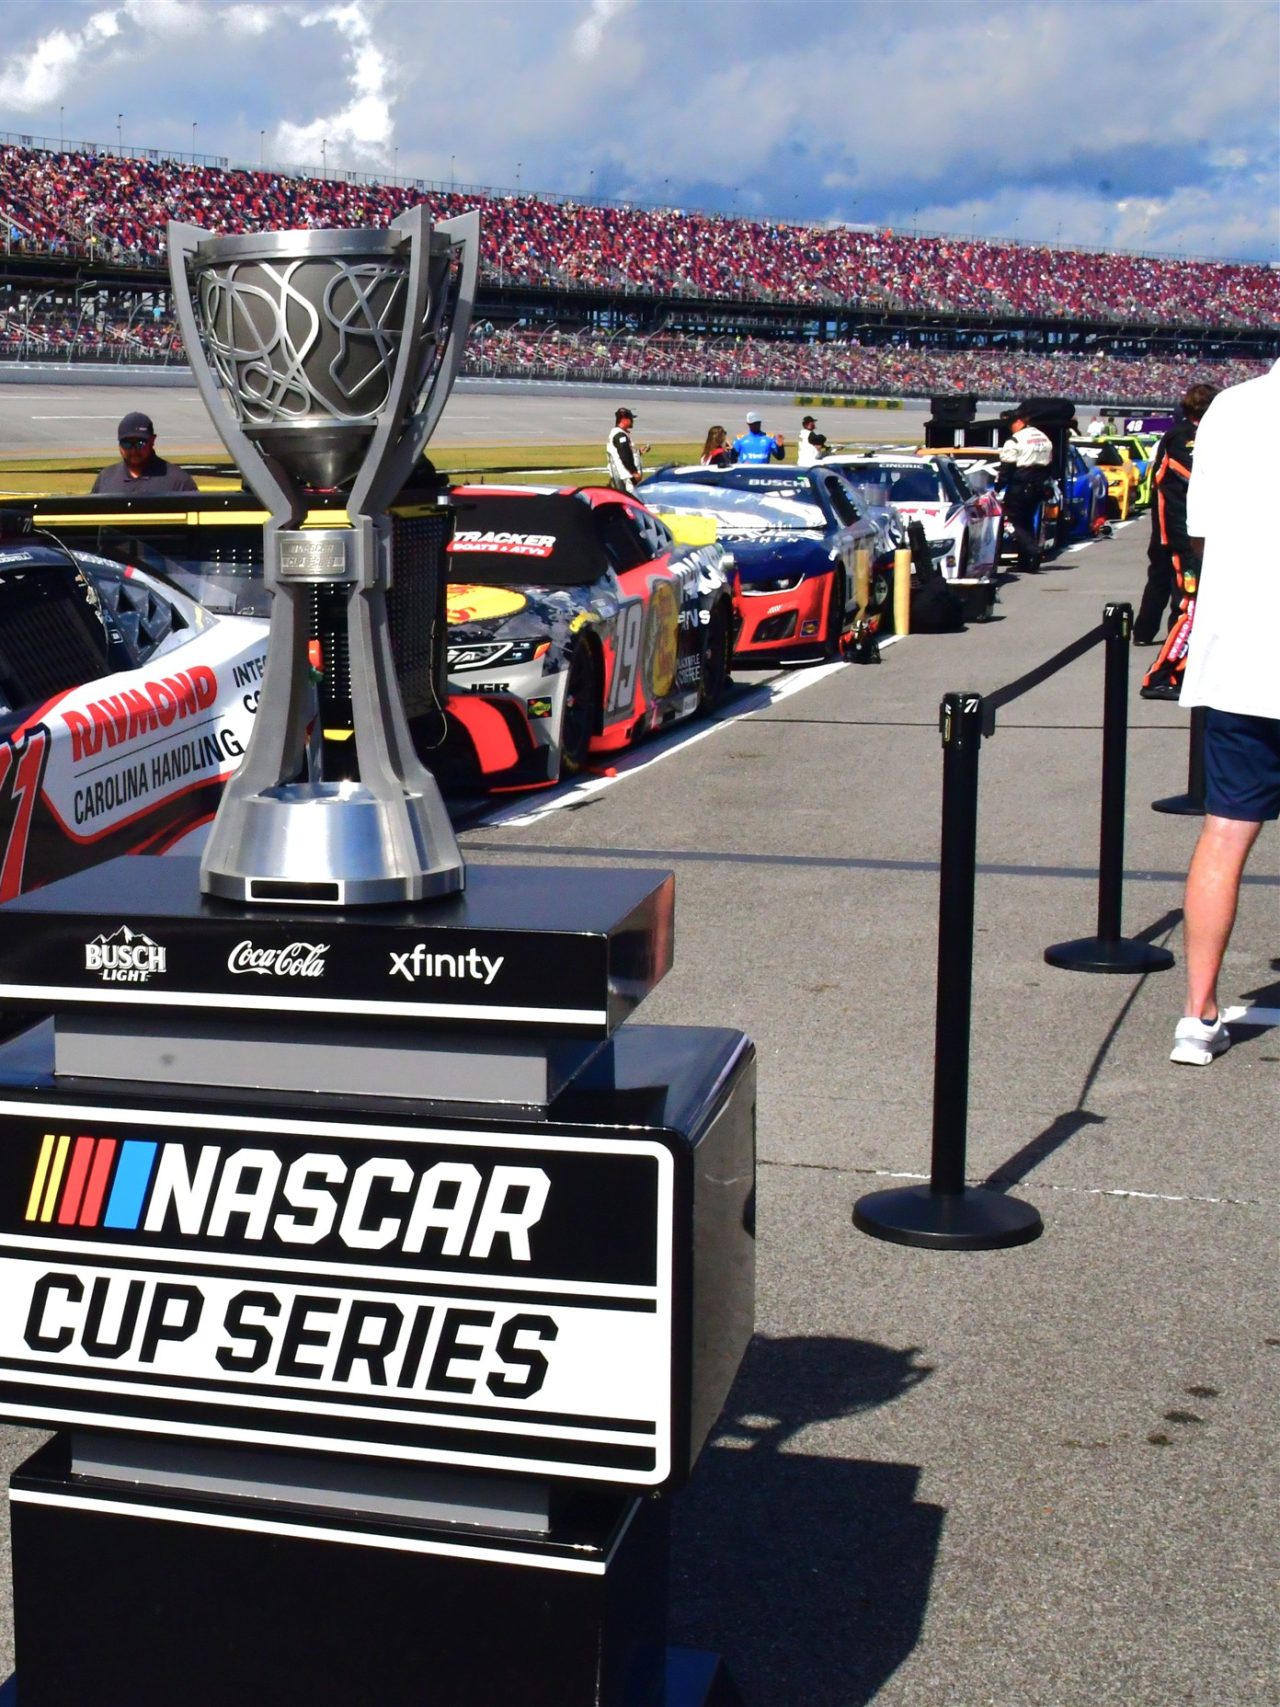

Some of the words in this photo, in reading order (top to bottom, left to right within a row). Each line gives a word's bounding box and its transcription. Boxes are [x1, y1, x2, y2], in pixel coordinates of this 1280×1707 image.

[748, 479, 806, 488] BUSCH
[454, 531, 557, 547] TRACKER
[608, 603, 642, 713] 19
[470, 683, 510, 694] JGR
[61, 665, 218, 762] RAYMOND
[74, 772, 149, 825] CAROLINA
[152, 729, 245, 790] HANDLING
[85, 942, 167, 972] BUSCH
[102, 968, 148, 982] LIGHT
[227, 939, 330, 978] Coca-Cola
[389, 944, 504, 984] xfinity
[144, 1142, 551, 1262] NASCAR
[23, 1271, 206, 1364] CUP
[215, 1290, 559, 1400] SERIES
